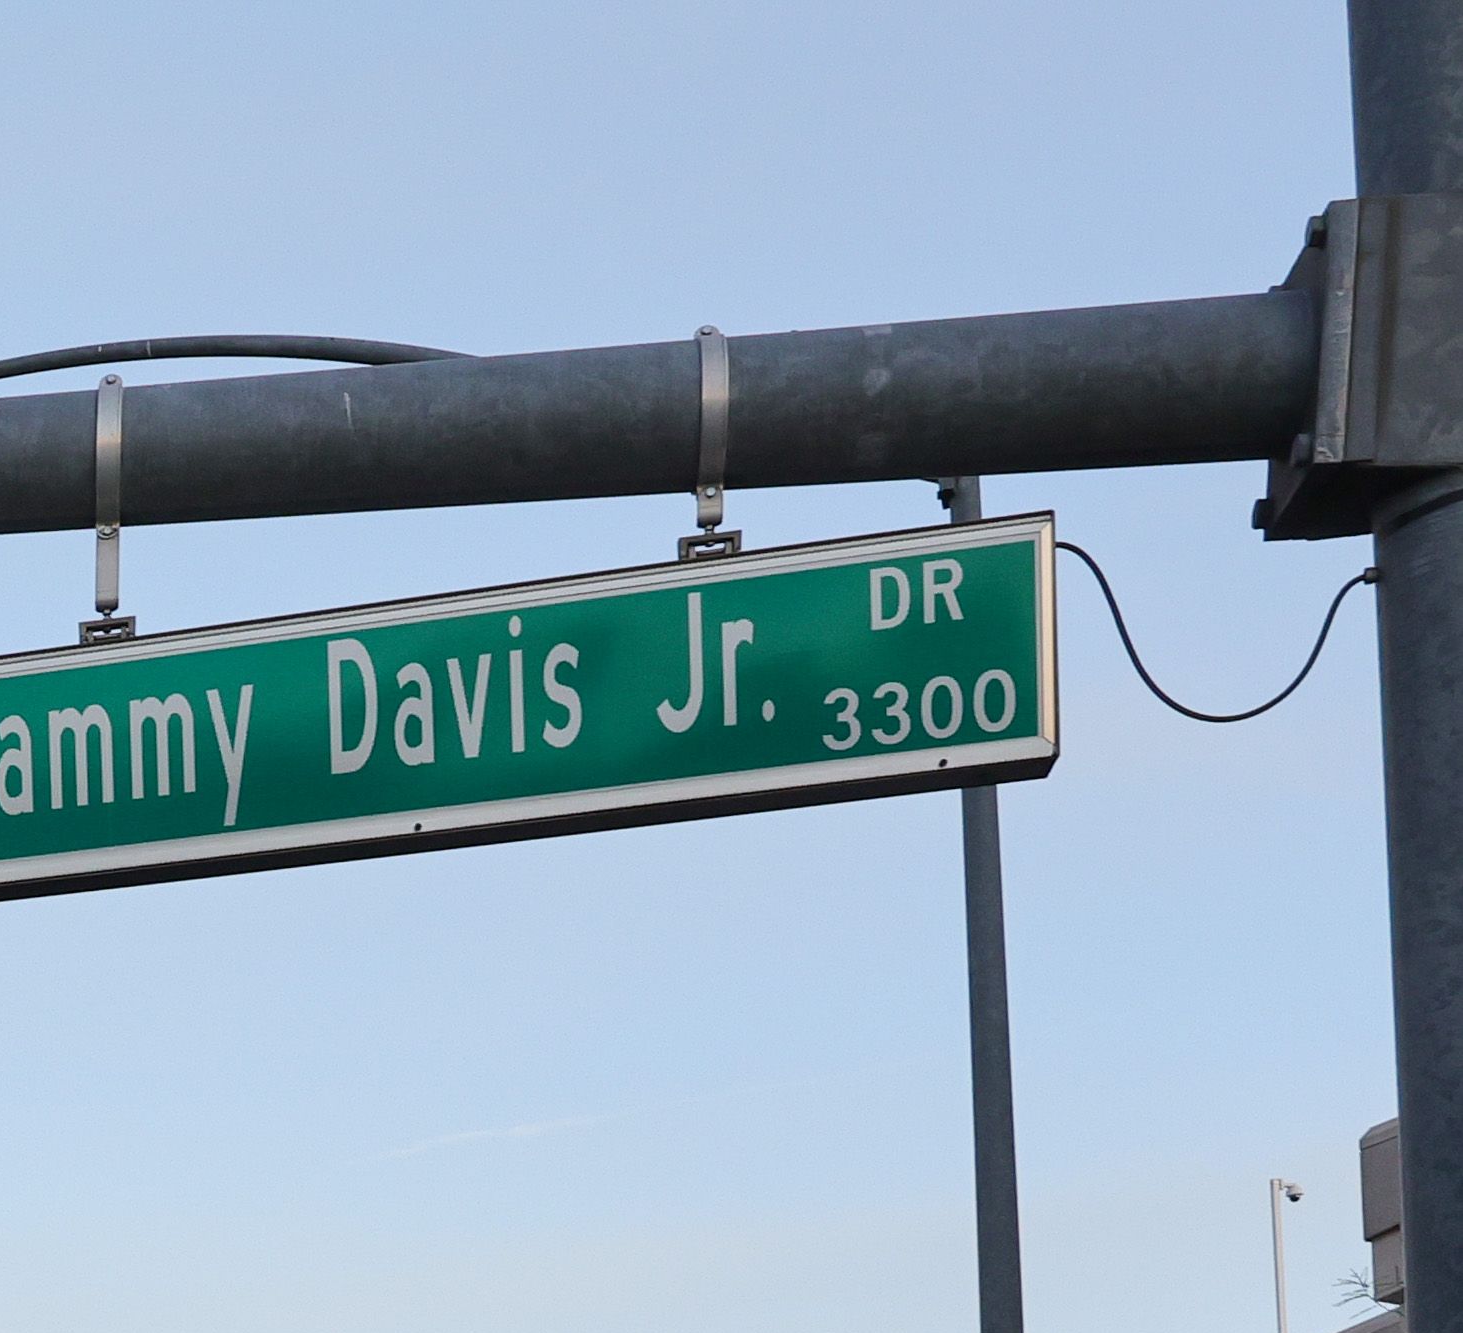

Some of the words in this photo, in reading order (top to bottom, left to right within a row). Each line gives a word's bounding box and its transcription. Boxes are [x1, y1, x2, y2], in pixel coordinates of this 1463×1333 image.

[868, 560, 965, 632] DR
[325, 614, 585, 777] Davis
[655, 591, 778, 736] Jr.
[822, 668, 1017, 755] 3300
